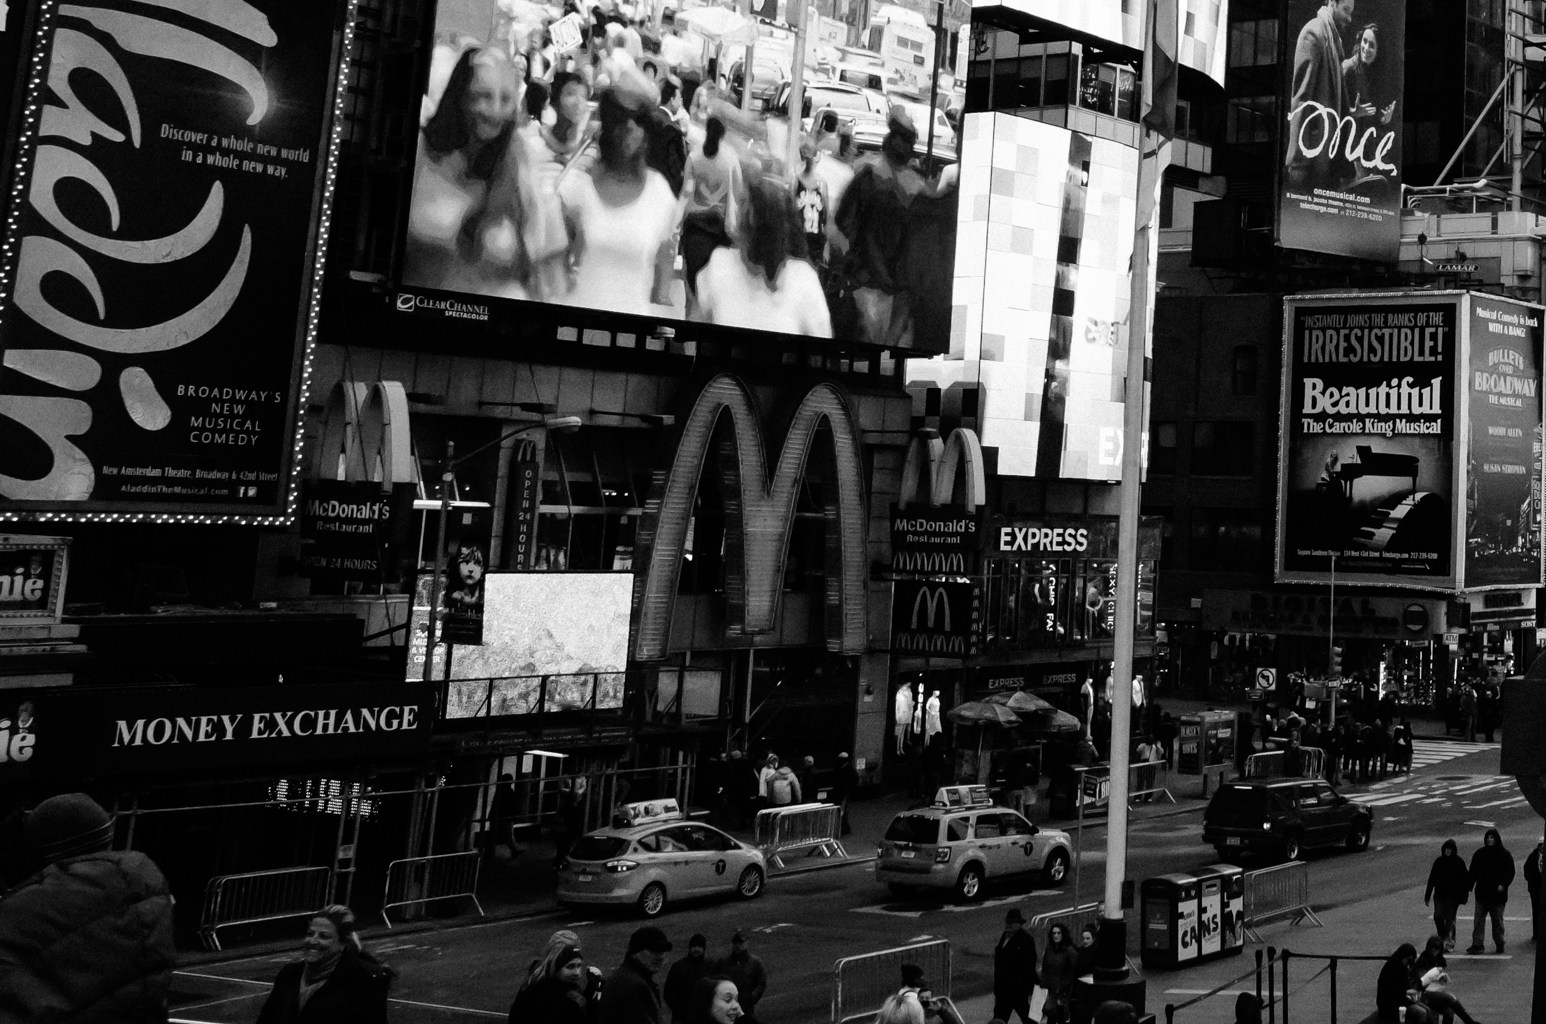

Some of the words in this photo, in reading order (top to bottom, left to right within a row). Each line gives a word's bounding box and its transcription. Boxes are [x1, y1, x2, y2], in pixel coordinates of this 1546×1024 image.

[160, 124, 209, 144] Discover
[211, 136, 218, 147] a
[221, 135, 253, 153] whole
[257, 143, 278, 157] new
[281, 146, 309, 163] world
[181, 146, 193, 162] in
[196, 152, 203, 163] a
[206, 152, 239, 170] whole
[243, 159, 264, 174] new
[267, 164, 288, 180] way.
[1313, 188, 1371, 204] oncemusical.com
[1346, 314, 1370, 327] JOINS
[1371, 313, 1385, 326] THE
[1388, 313, 1414, 326] RANKS
[1417, 312, 1429, 326] OF
[1429, 312, 1444, 326] THE
[1476, 306, 1497, 320] Musical
[1498, 311, 1519, 325] Comedy
[1488, 321, 1503, 334] WITH
[1504, 325, 1508, 335] A
[1488, 348, 1524, 371] BULLETS
[1475, 371, 1537, 397] BROADWAY
[177, 384, 281, 403] BROADWAY'S
[1302, 376, 1442, 415] Beautiful
[211, 403, 246, 414] NEW
[190, 416, 261, 432] MUSICAL
[1302, 418, 1324, 433] The
[1325, 418, 1363, 433] Carole
[1364, 418, 1394, 437] King
[1395, 418, 1442, 434] Musical
[189, 431, 259, 446] COMEDY
[102, 465, 119, 475] New
[121, 466, 162, 476] Amsterdam
[305, 499, 390, 520] McDonald's
[316, 521, 373, 533] Restaurant
[894, 518, 976, 534] McDonald's
[906, 534, 961, 544] Restaurant
[1000, 527, 1088, 552] EXPRESS
[344, 558, 378, 571] HOURS
[112, 714, 247, 747] MONEY
[249, 705, 418, 740] EXCHANGE
